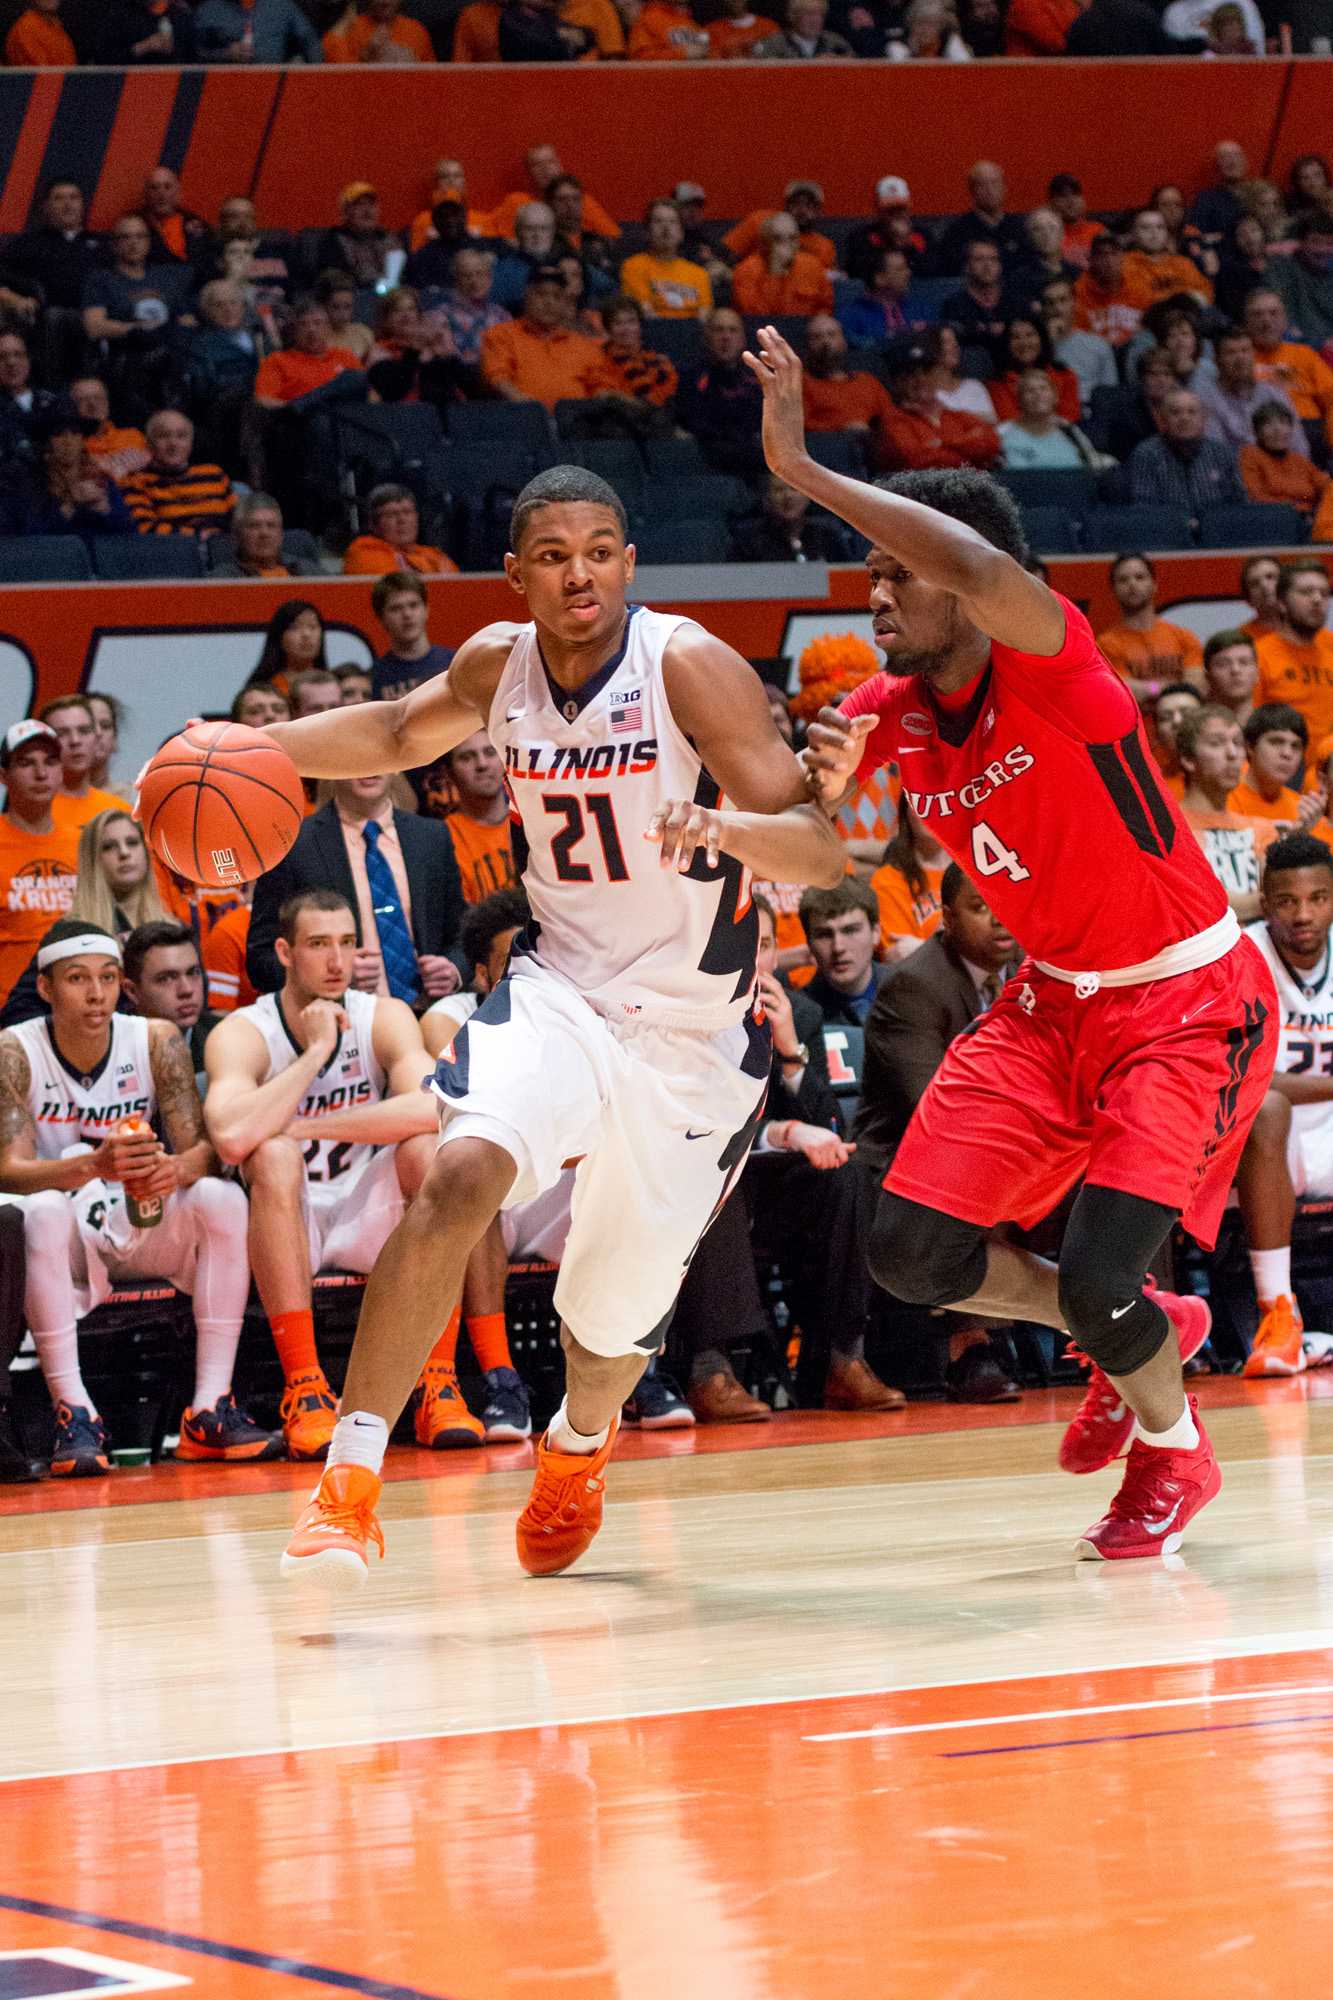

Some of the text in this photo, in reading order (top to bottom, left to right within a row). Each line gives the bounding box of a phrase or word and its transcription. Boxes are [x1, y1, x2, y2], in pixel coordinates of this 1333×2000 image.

[505, 739, 658, 780] ILLINOIS
[902, 745, 1036, 818] UTGERS
[541, 792, 631, 882] 21
[971, 820, 1032, 883] 4
[8, 890, 73, 912] KRUS
